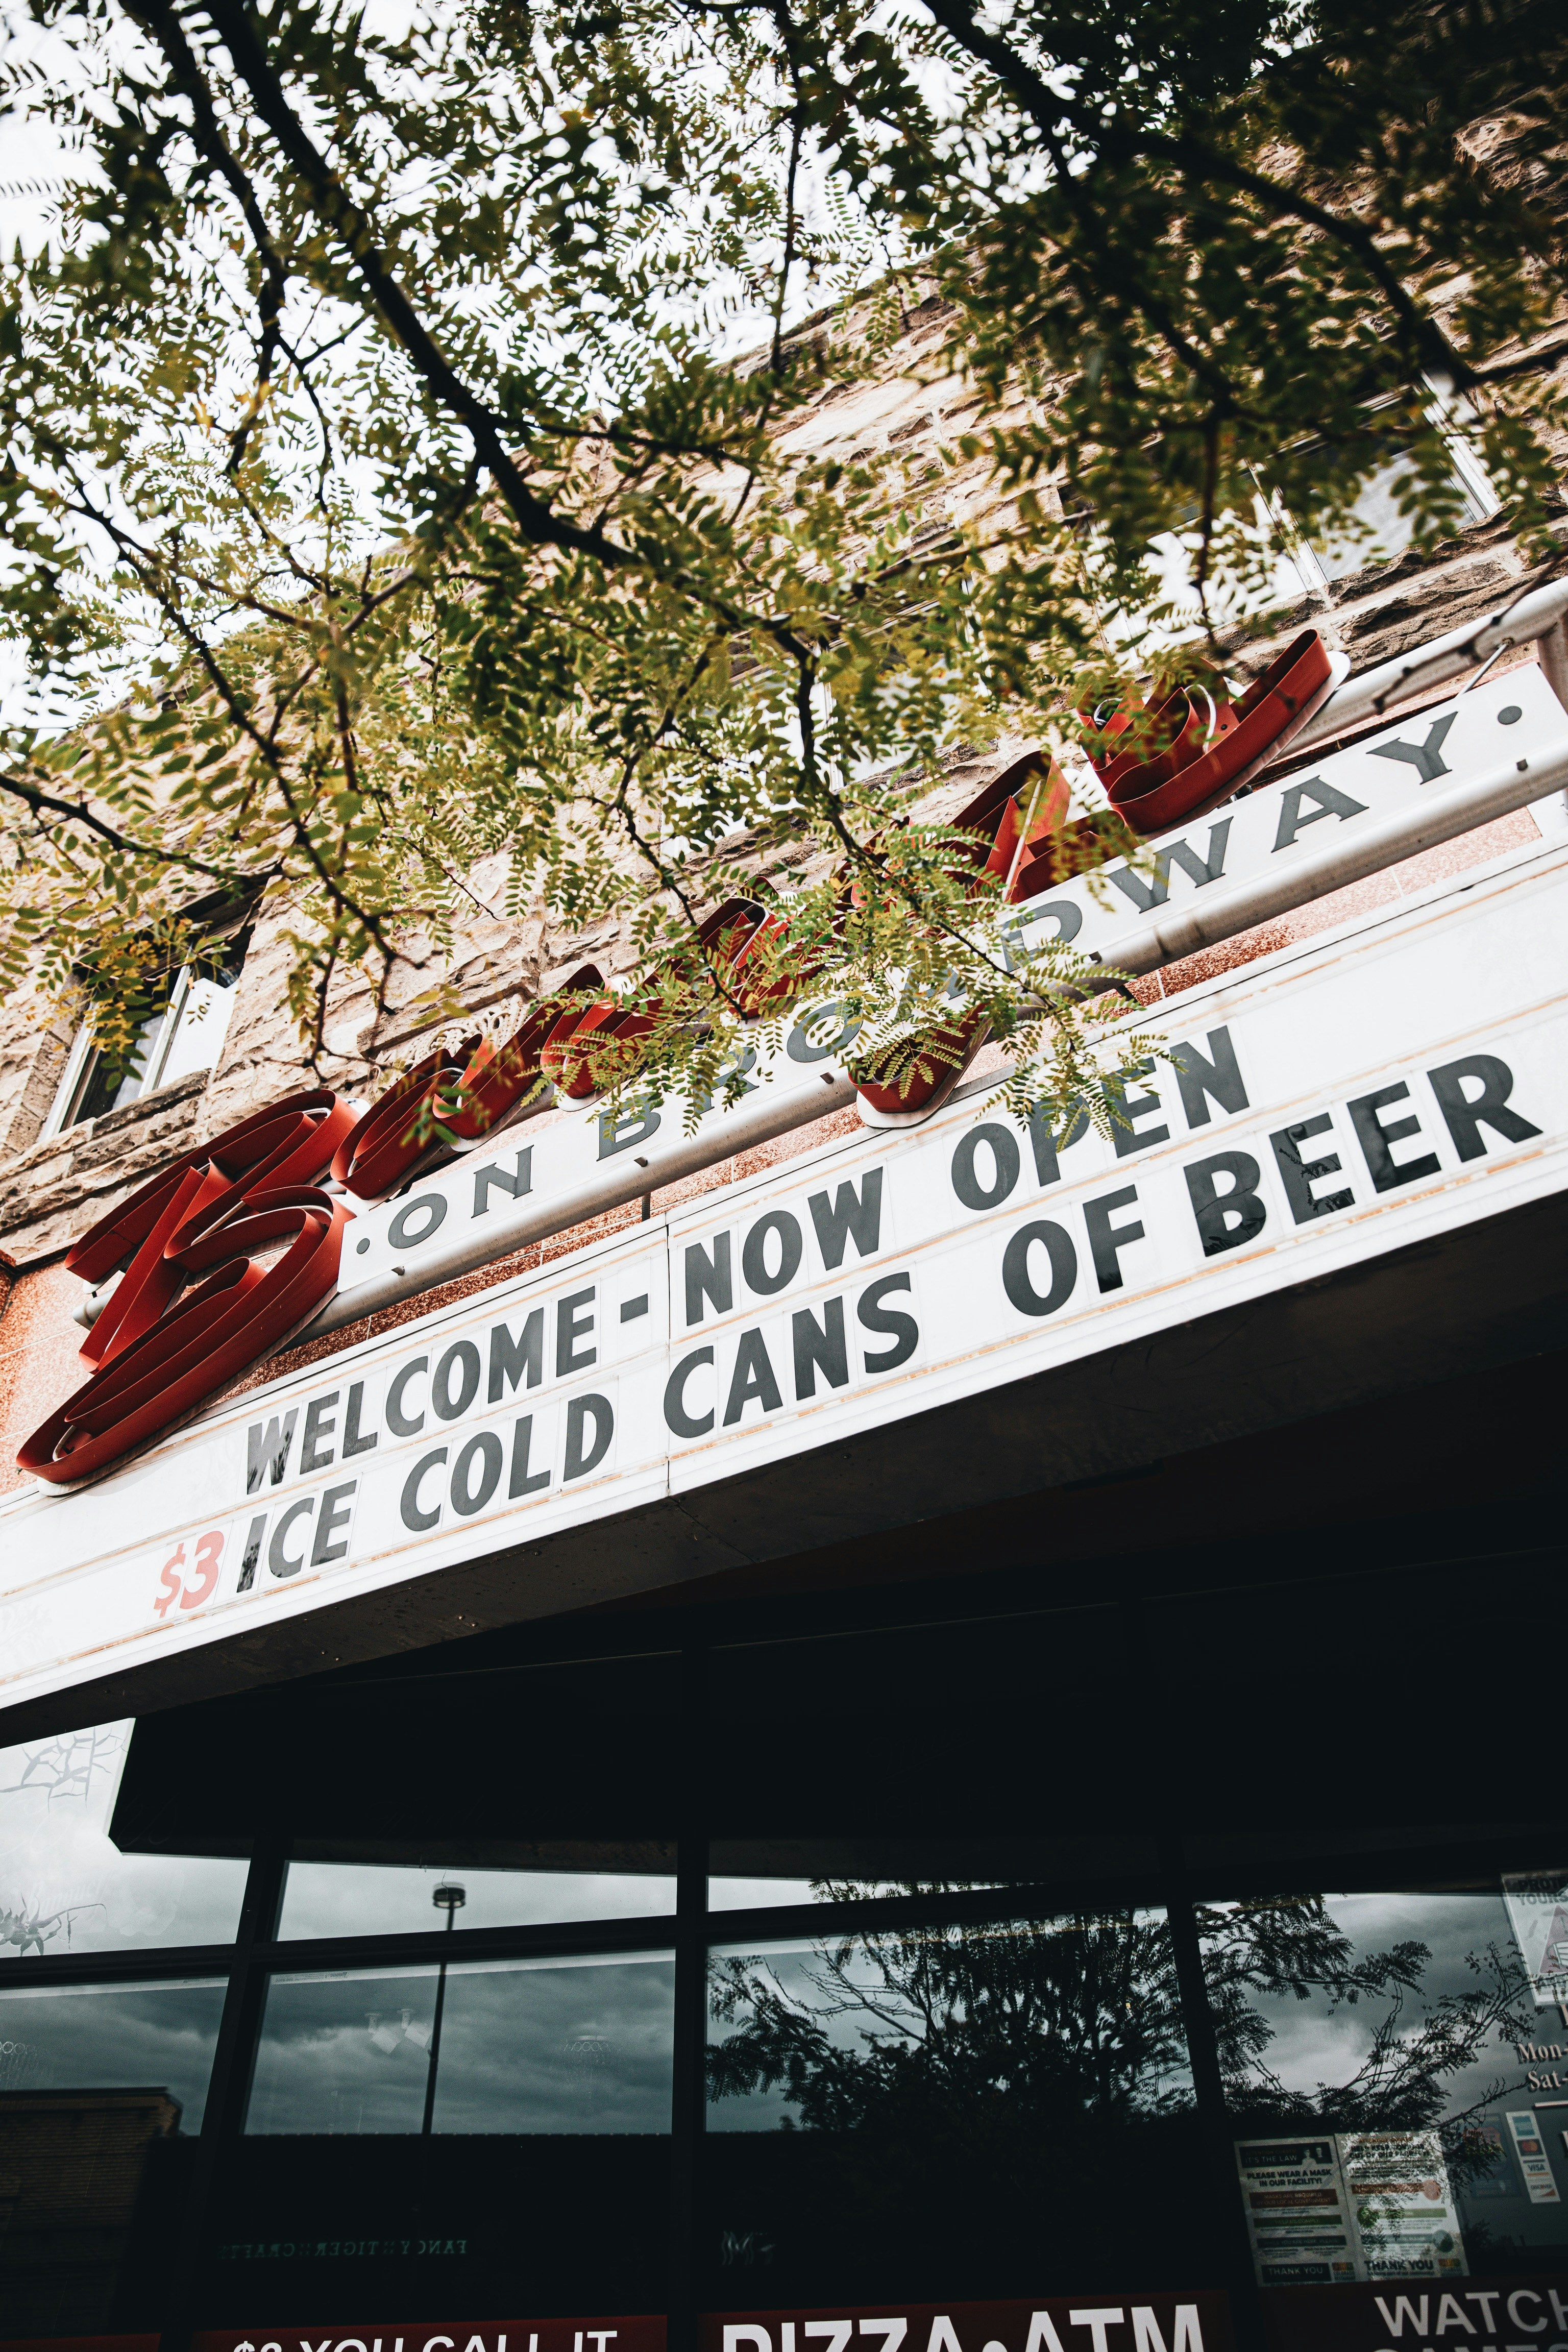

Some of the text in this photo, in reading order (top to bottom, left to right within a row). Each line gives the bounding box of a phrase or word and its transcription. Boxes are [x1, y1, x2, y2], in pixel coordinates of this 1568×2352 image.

[685, 1166, 884, 1327] NOW
[951, 1025, 1250, 1212] OPEN
[387, 1143, 533, 1249] ON
[153, 1054, 1542, 1619] $3 ICE COLD CANS OF BEER
[1517, 1876, 1568, 1892] PROTE
[1527, 2163, 1546, 2171] VISA
[1246, 2171, 1276, 2179] PLEASE
[1287, 2177, 1322, 2186] FACILITY!
[1363, 2259, 1434, 2270] THANK YOU
[1268, 2266, 1323, 2275] THANK YOU
